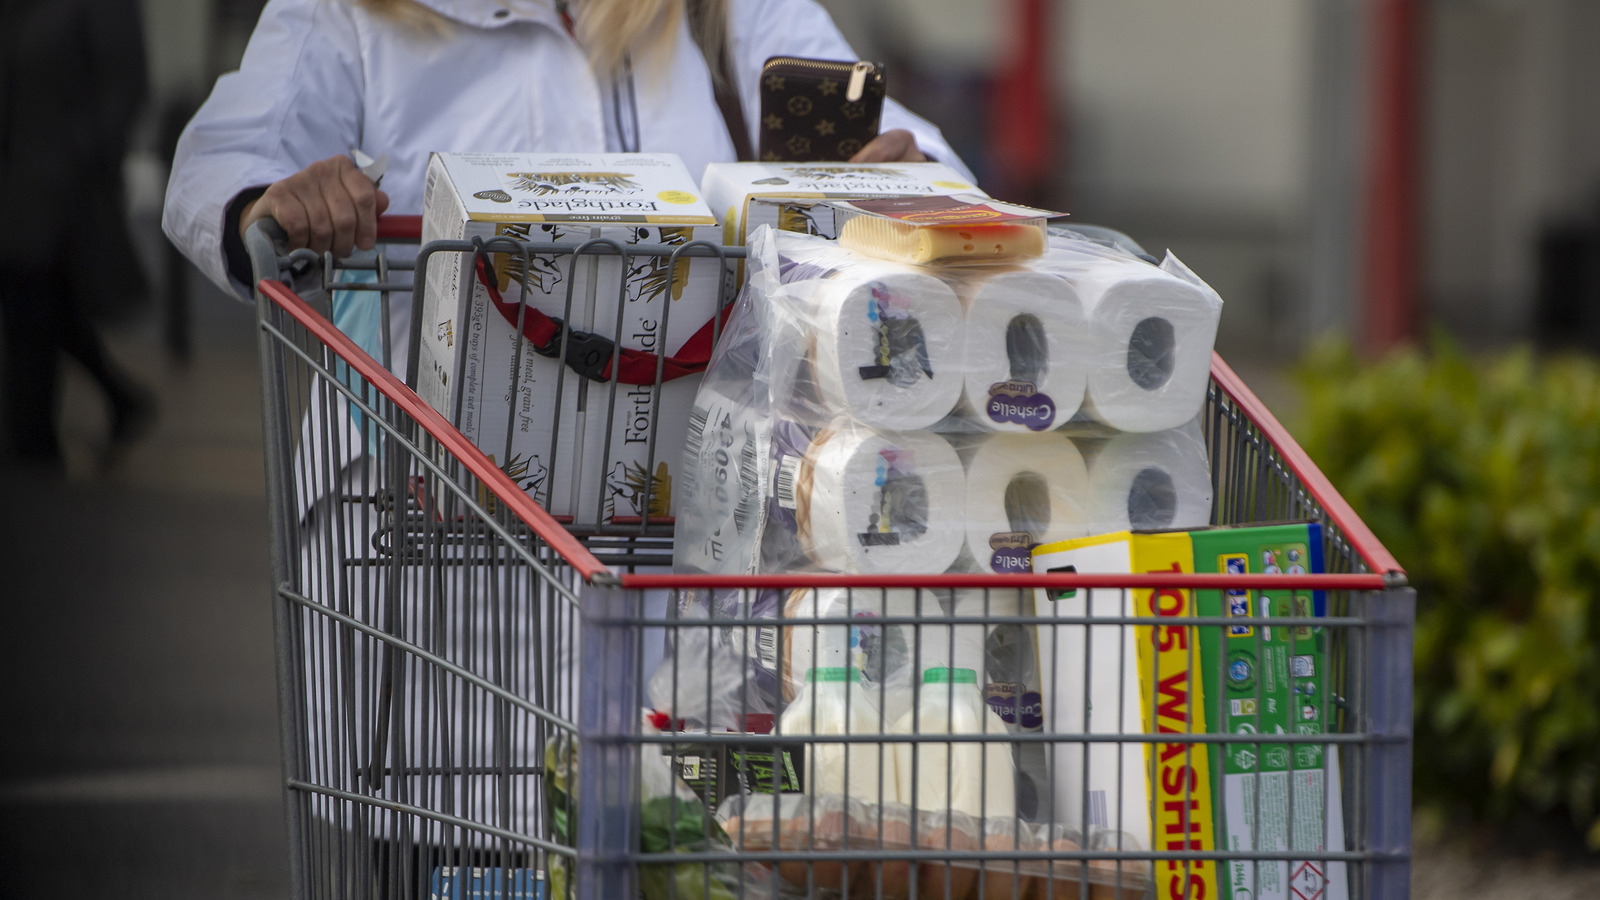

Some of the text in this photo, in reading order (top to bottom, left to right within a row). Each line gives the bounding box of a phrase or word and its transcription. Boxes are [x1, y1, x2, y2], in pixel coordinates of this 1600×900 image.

[798, 180, 935, 193] Forthglade
[518, 197, 661, 212] Forthglade
[594, 214, 623, 222] grain
[469, 332, 481, 350] trays
[469, 351, 480, 362] of
[466, 361, 479, 395] complete
[466, 395, 476, 410] wet
[520, 384, 535, 413] grain
[465, 410, 476, 434] meals
[518, 411, 534, 433] free
[995, 555, 1031, 570] shelle
[1147, 561, 1188, 653] 105
[1156, 669, 1206, 900] WASHES
